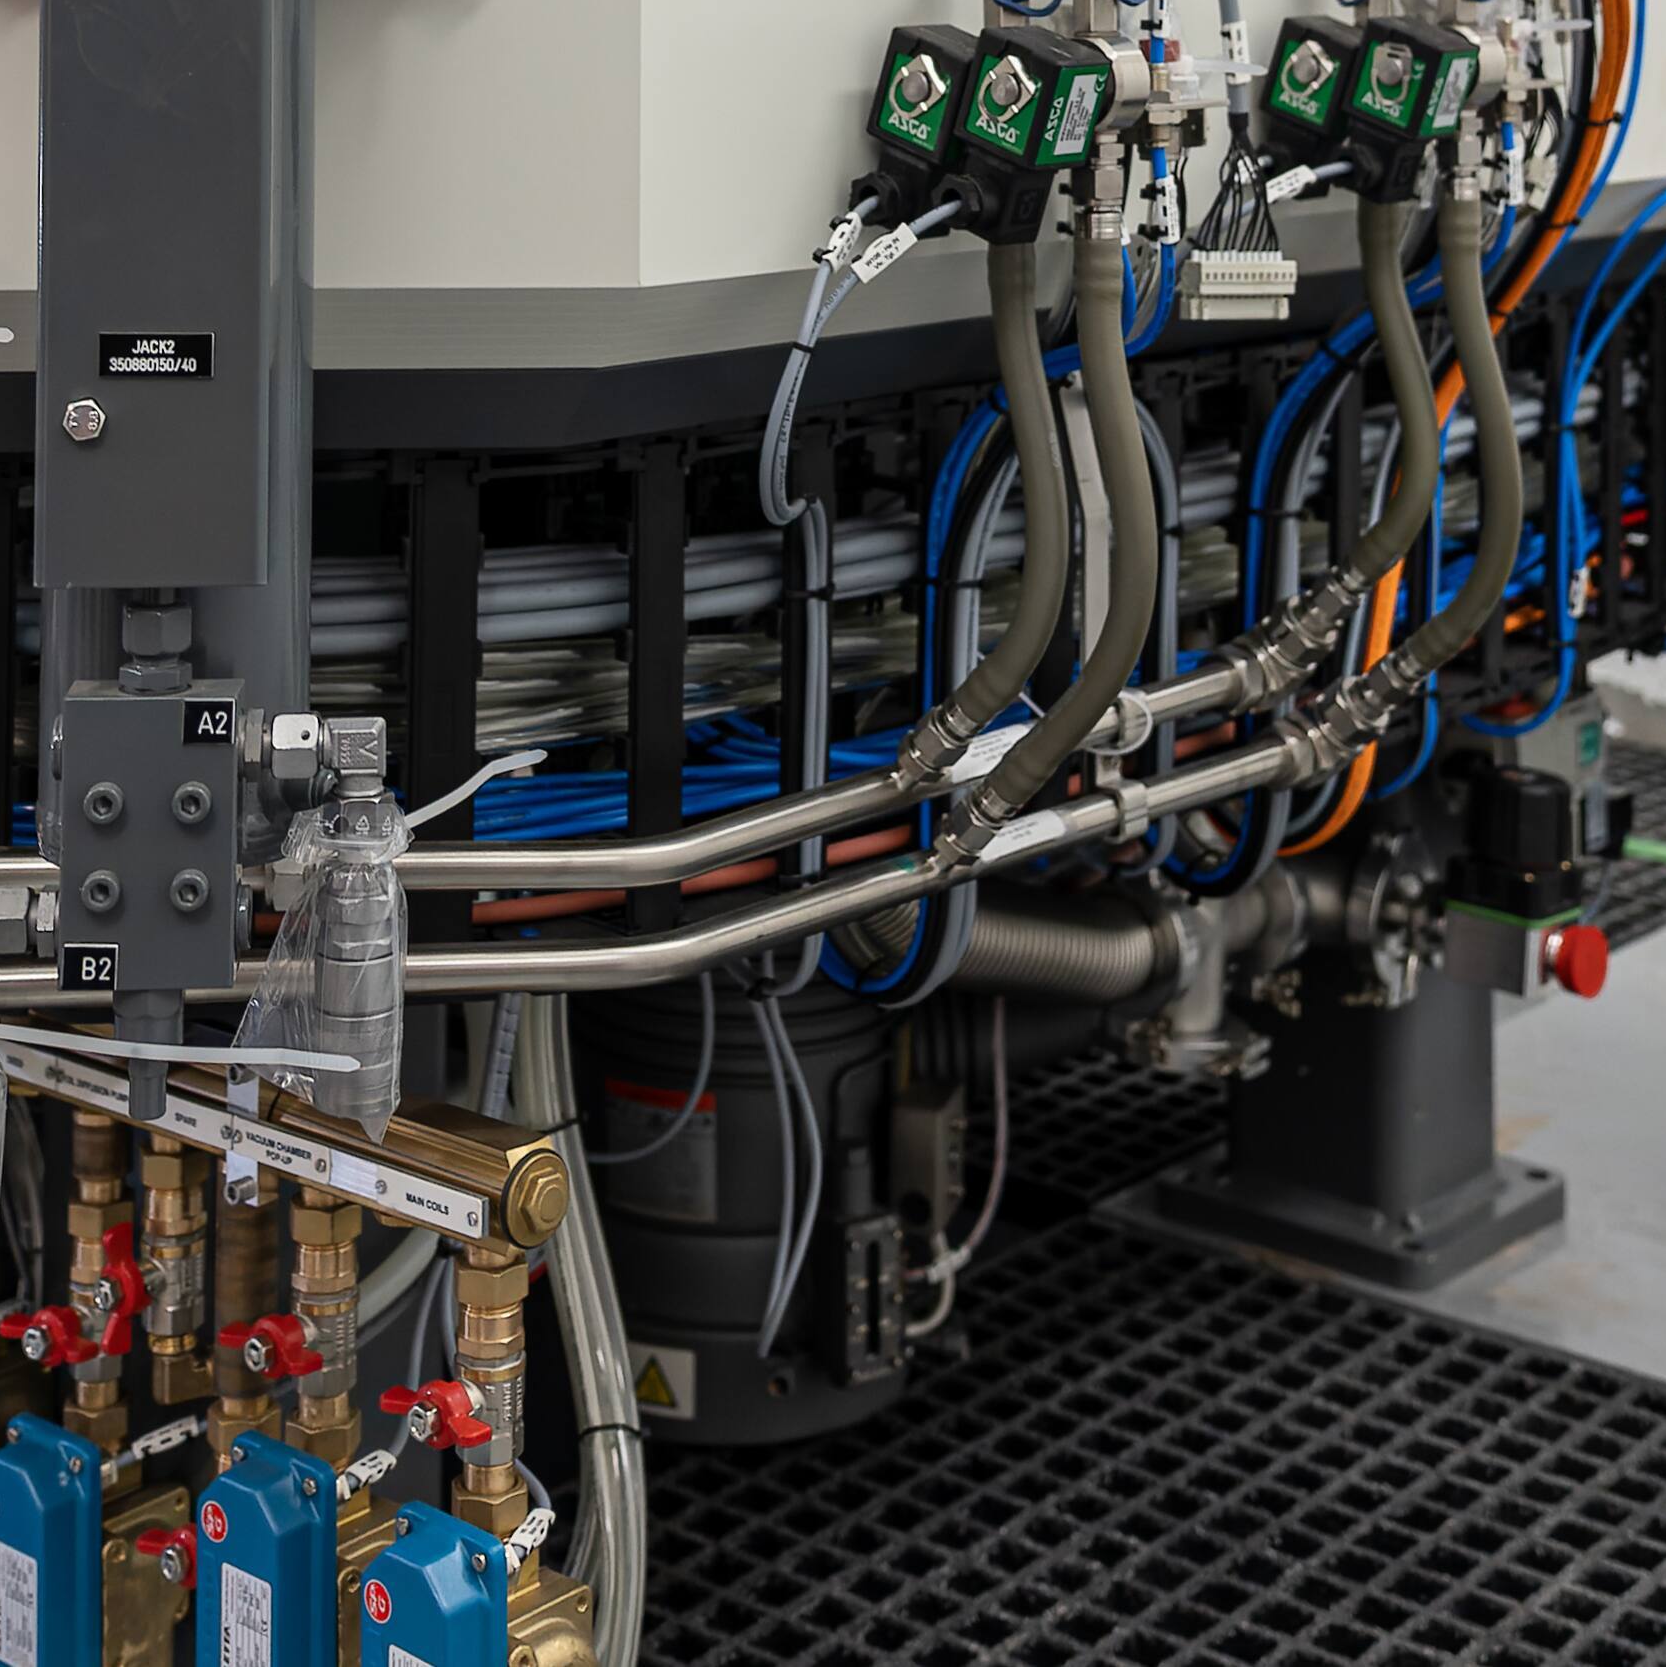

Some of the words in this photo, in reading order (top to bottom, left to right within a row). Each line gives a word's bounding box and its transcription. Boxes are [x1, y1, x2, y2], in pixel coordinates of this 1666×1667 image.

[888, 112, 930, 140] ASCO
[976, 116, 1019, 144] ASCO
[1044, 96, 1064, 142] ASCO
[131, 339, 175, 354] JACK2
[197, 711, 228, 736] A2
[81, 956, 111, 982] B2
[245, 1131, 276, 1149] VACUUM
[276, 1141, 312, 1160] CHAMBER
[405, 1192, 425, 1207] MAIN
[426, 1199, 450, 1215] COILS
